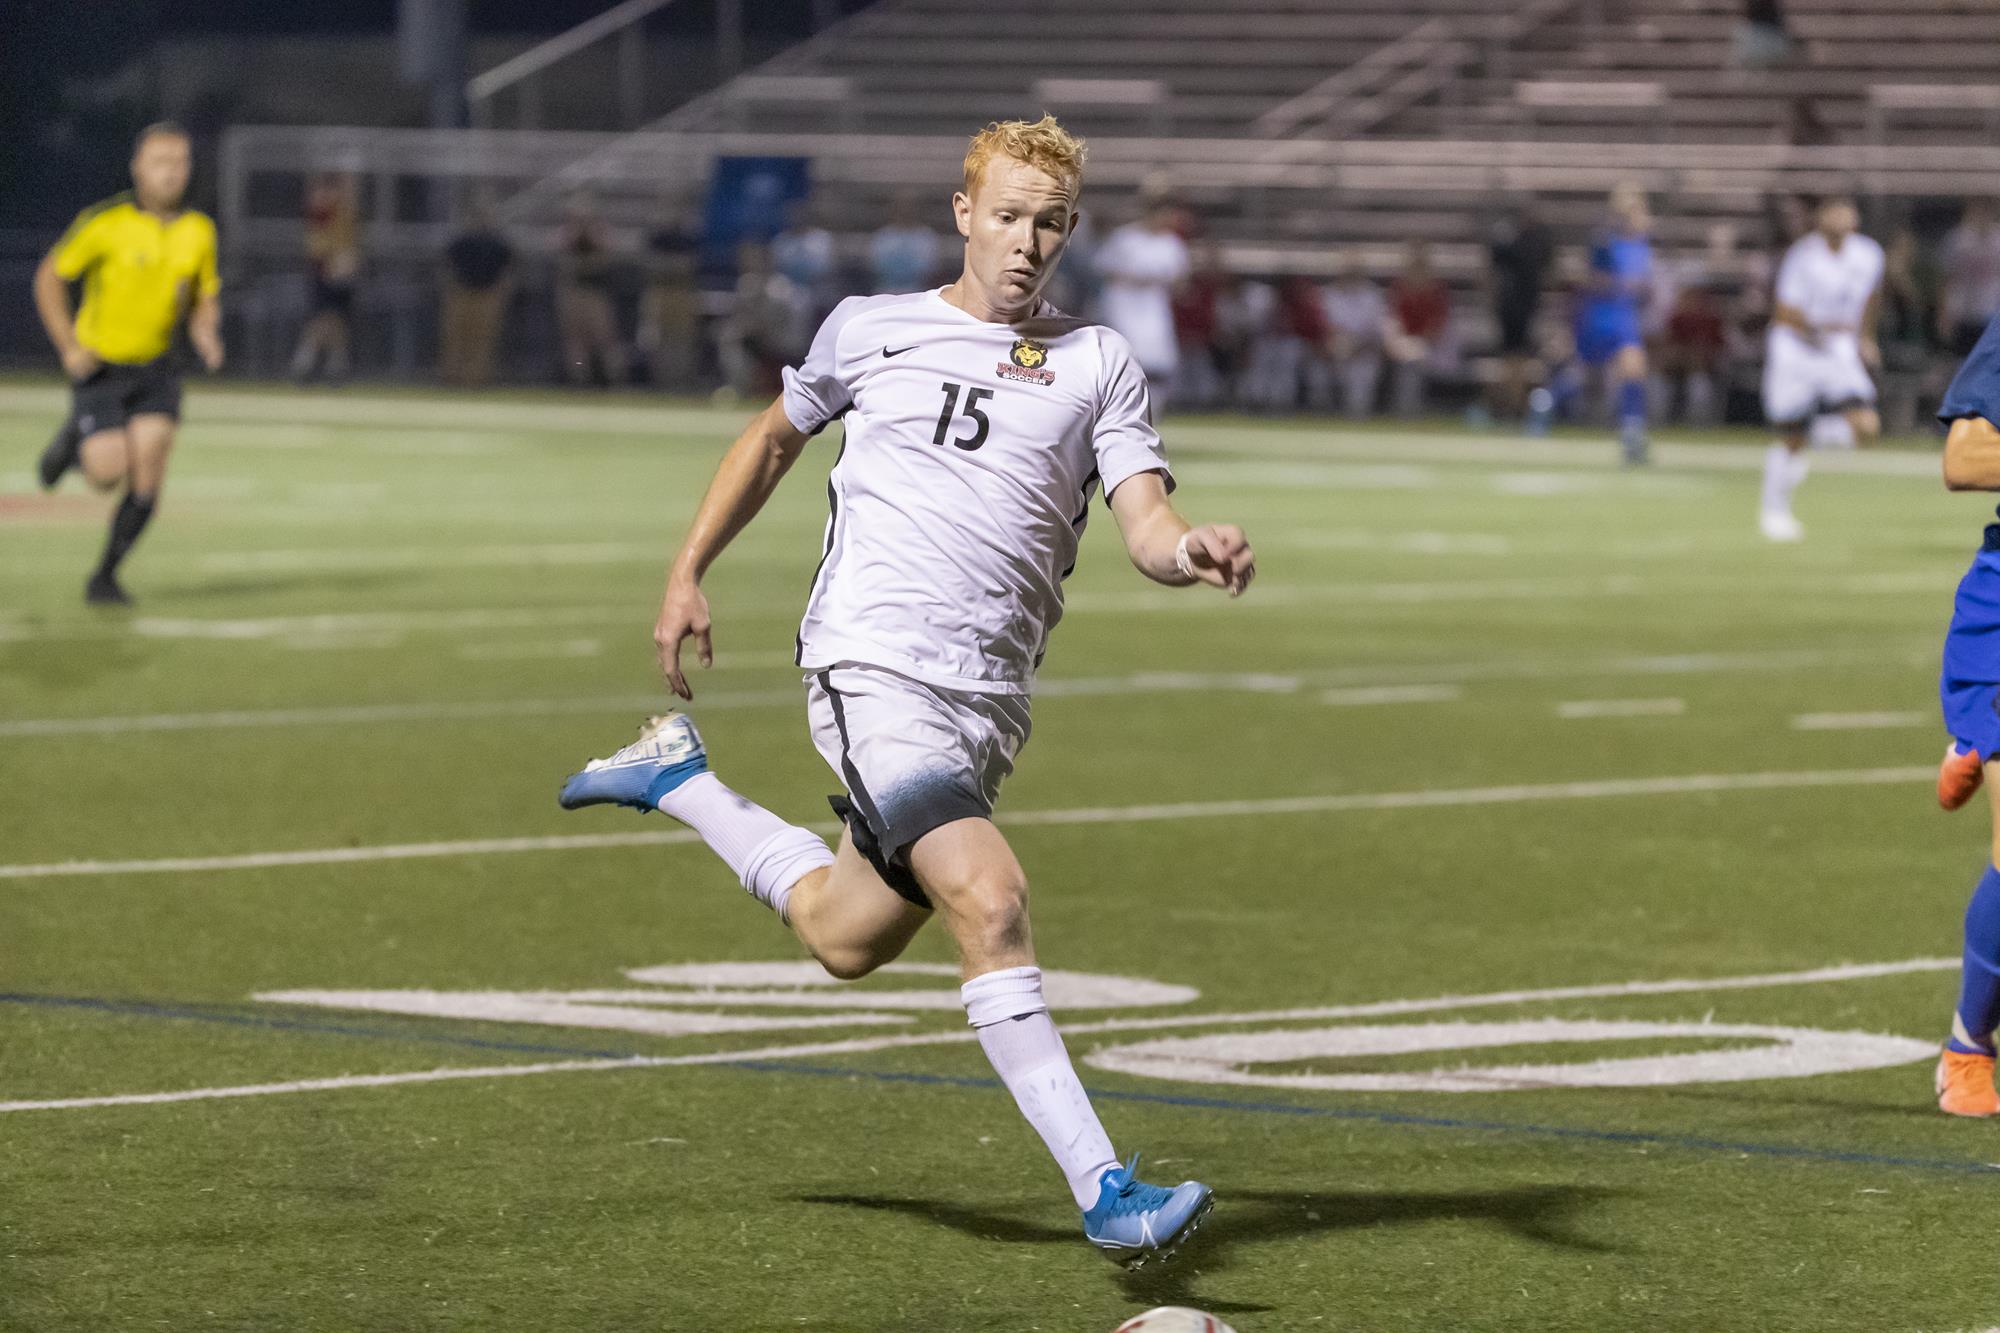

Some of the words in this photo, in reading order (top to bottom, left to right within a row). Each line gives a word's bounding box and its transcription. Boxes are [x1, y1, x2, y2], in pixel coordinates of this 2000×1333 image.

[998, 362, 1056, 381] KING'S
[1002, 372, 1046, 385] SOCCER
[932, 382, 994, 452] 15
